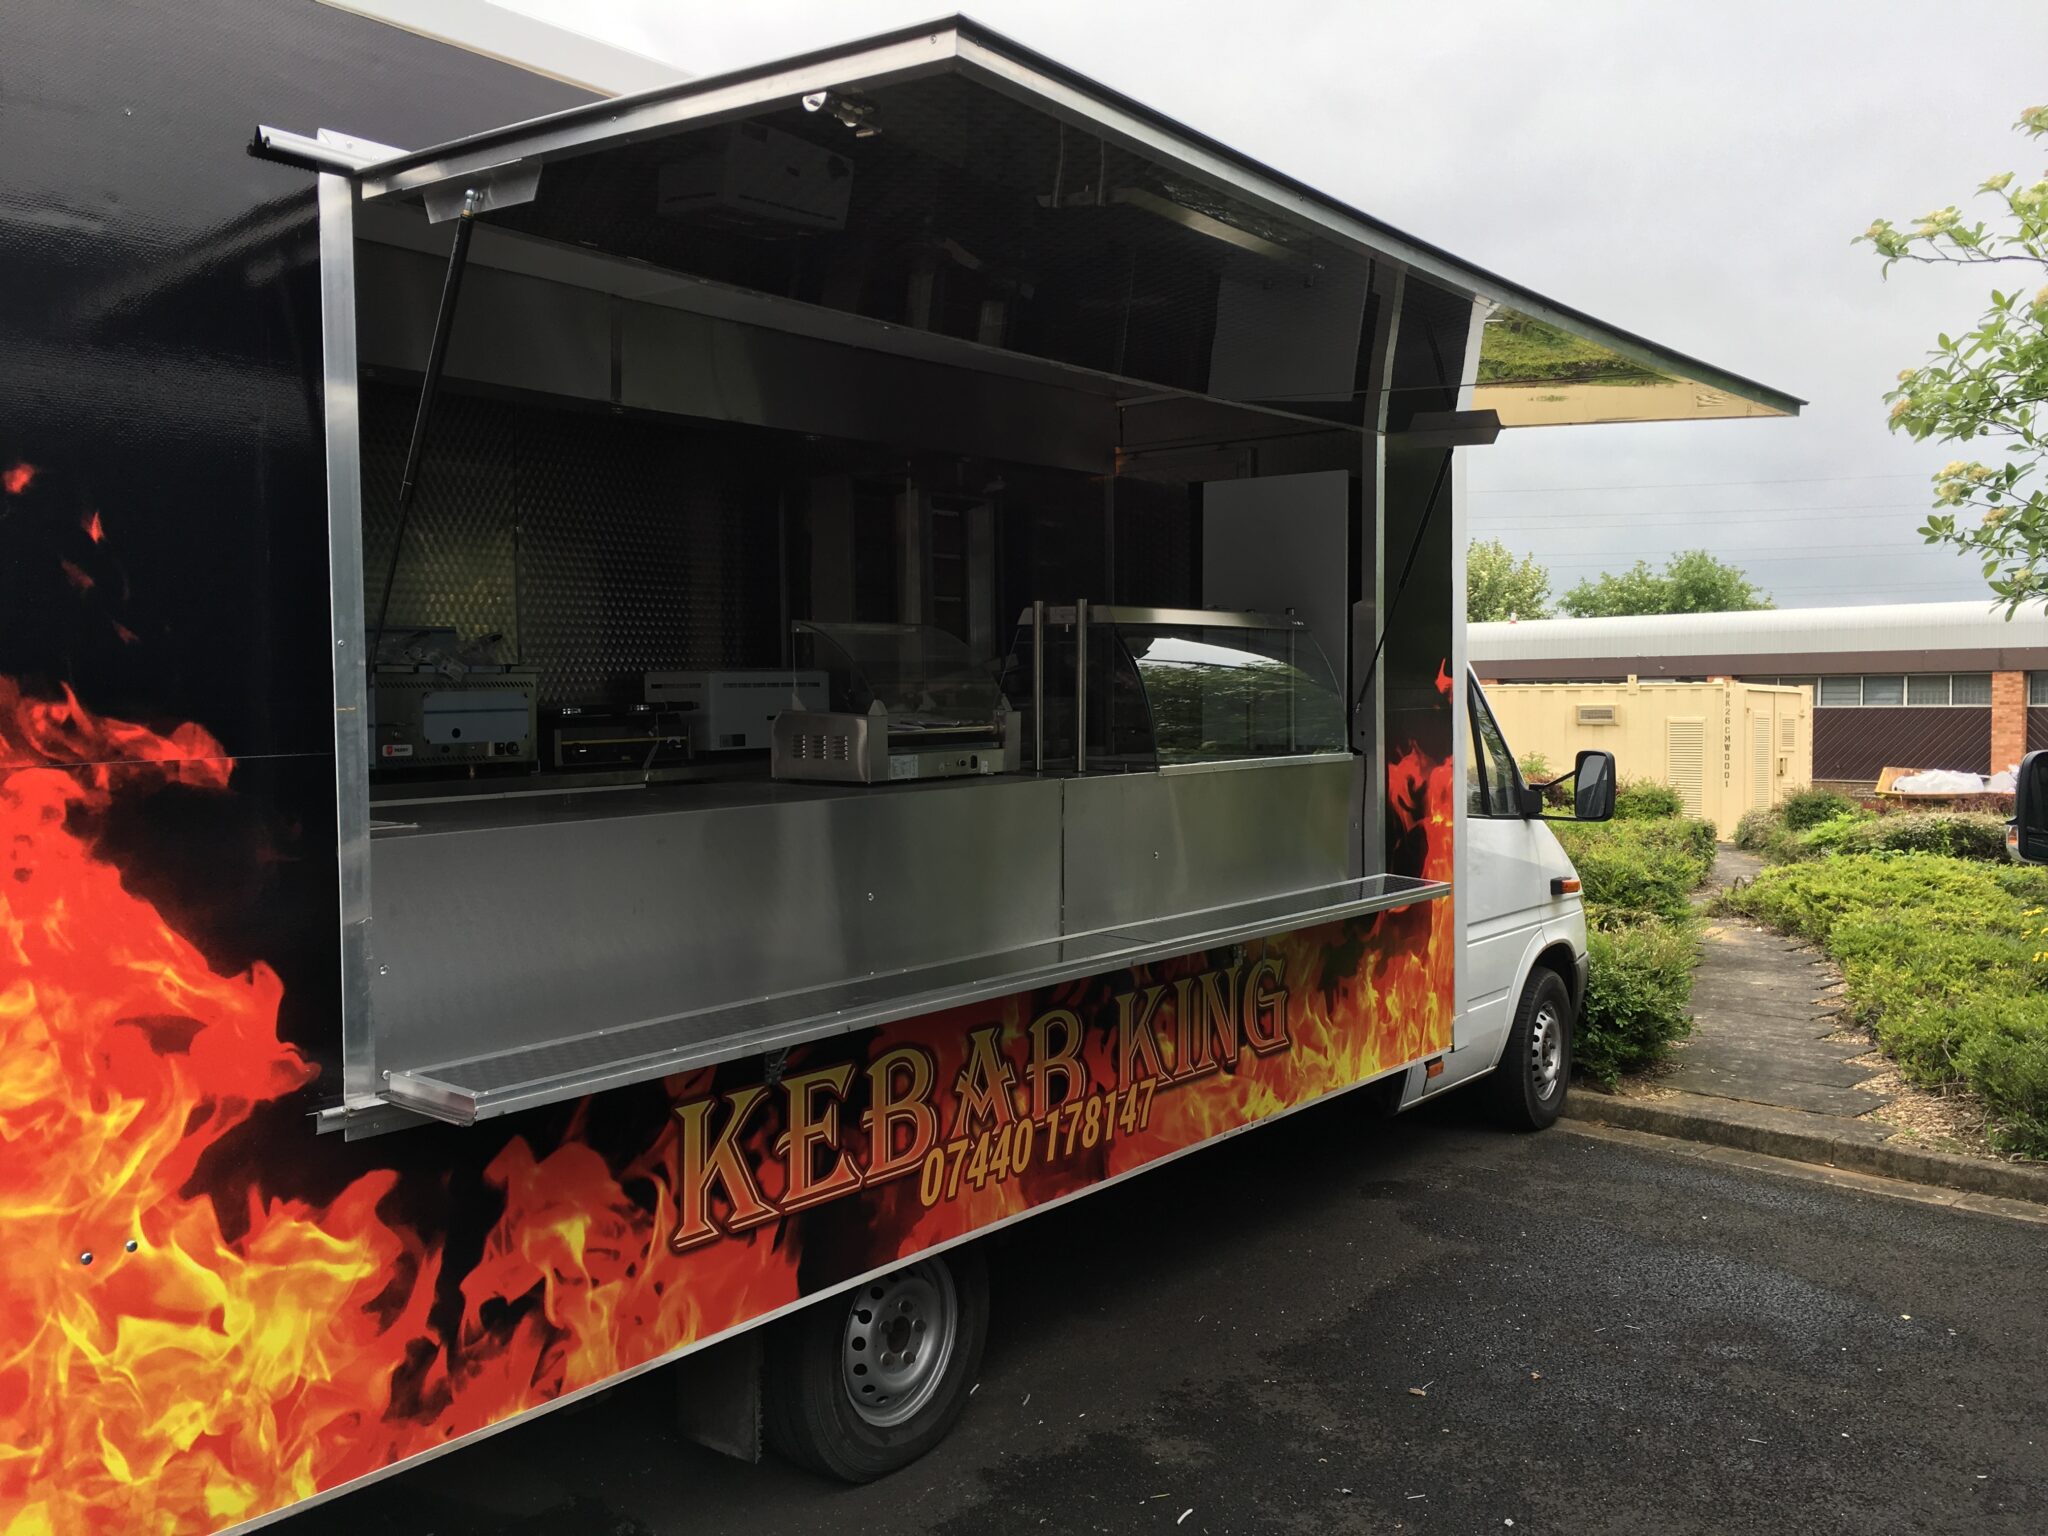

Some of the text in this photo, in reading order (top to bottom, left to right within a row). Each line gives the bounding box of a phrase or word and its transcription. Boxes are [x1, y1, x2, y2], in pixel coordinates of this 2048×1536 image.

[672, 957, 1291, 1249] KEBAB KING
[919, 1076, 1158, 1208] 07440 178147
